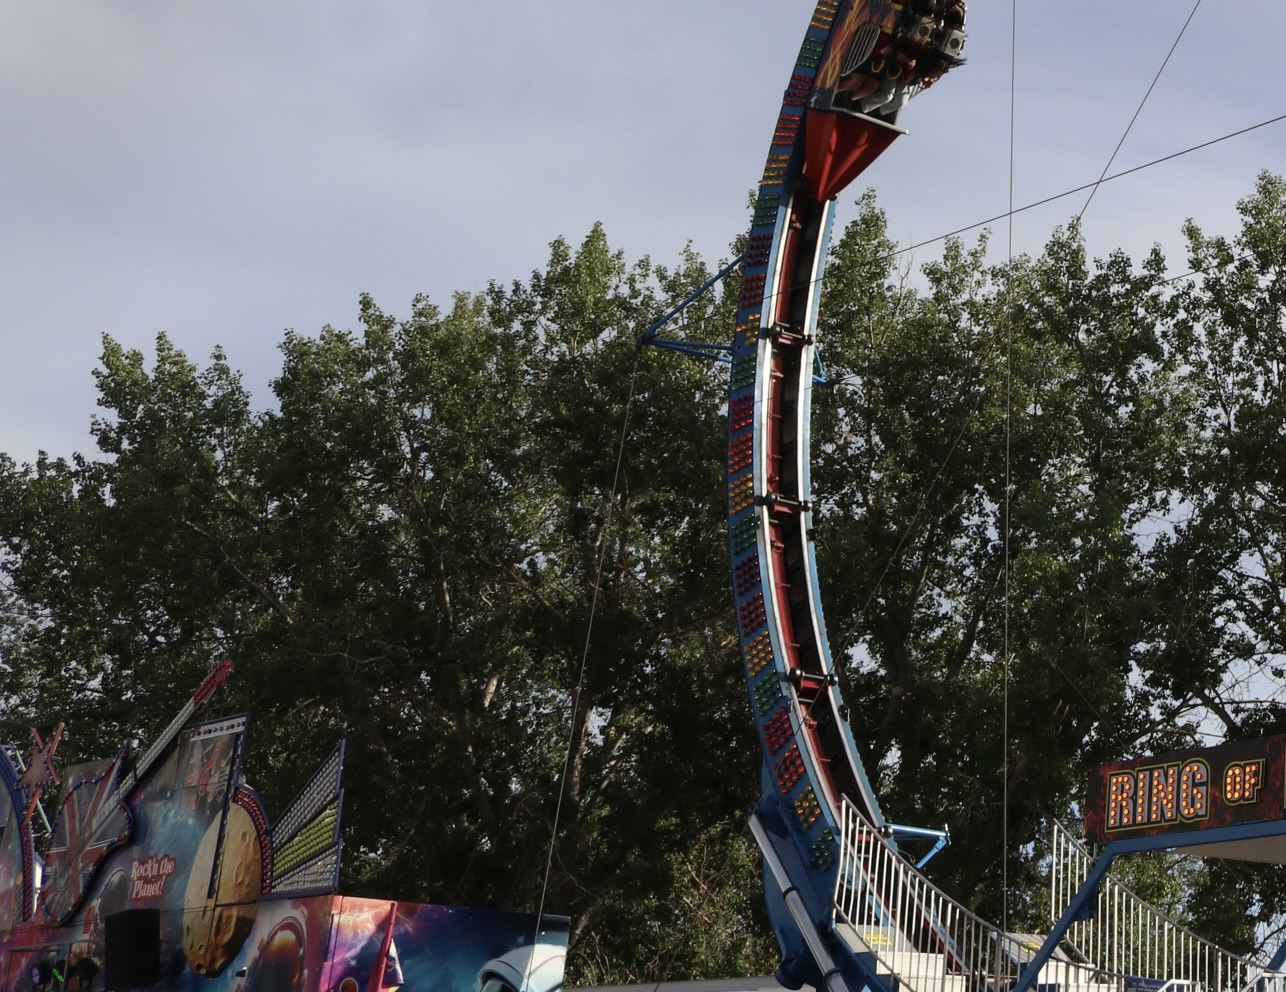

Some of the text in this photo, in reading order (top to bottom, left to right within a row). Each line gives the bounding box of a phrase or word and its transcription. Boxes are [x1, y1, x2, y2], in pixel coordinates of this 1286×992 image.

[1107, 761, 1208, 828] RING
[1225, 763, 1260, 801] OF
[131, 858, 175, 880] Rock'n the
[132, 875, 166, 898] Planet!
